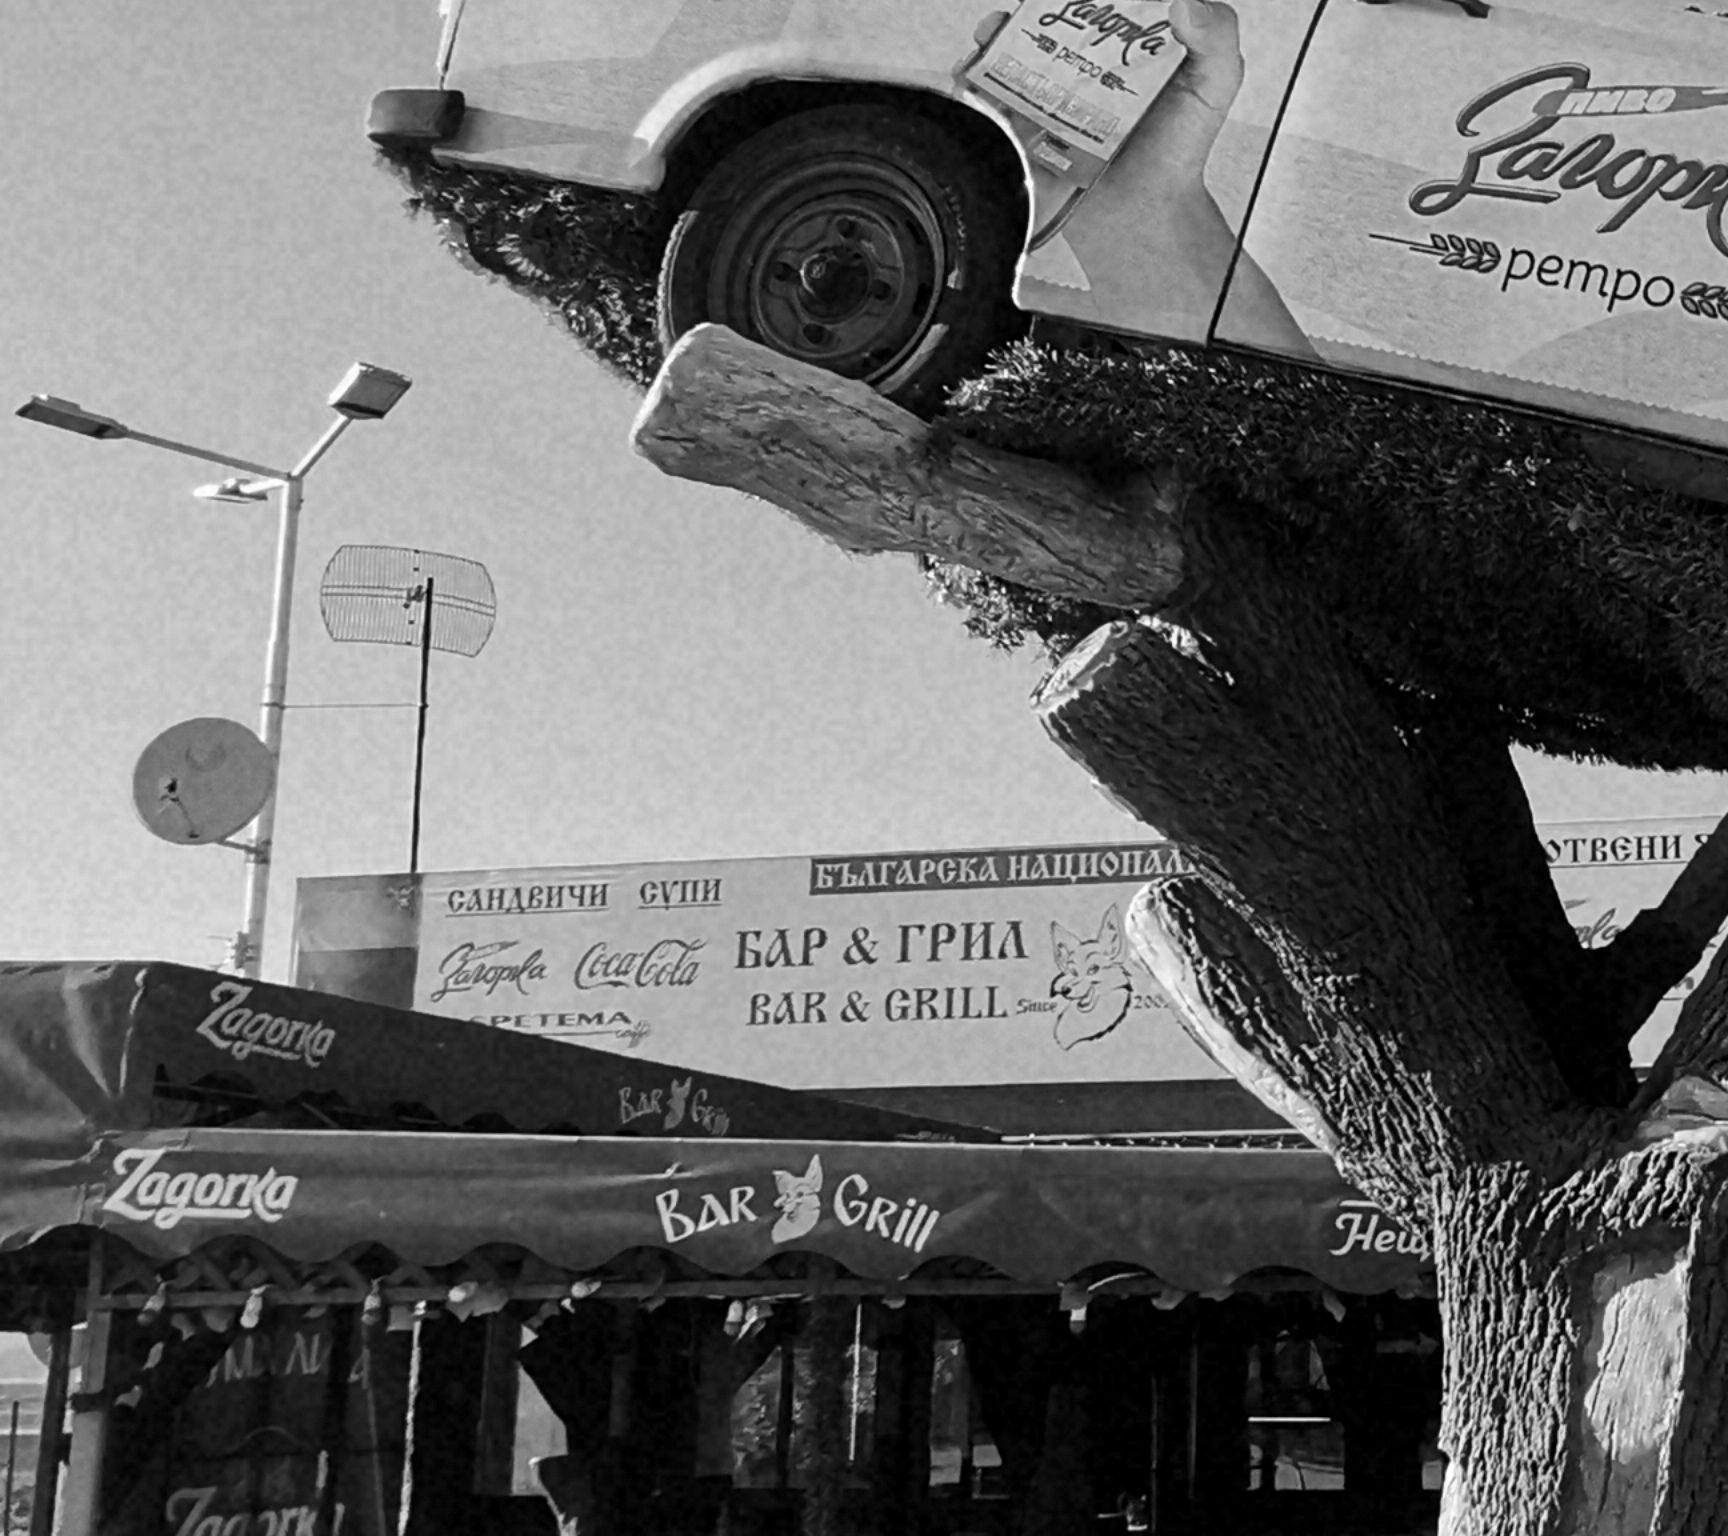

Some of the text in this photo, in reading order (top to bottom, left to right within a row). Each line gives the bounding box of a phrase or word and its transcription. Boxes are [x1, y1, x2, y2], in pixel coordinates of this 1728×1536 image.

[1501, 244, 1675, 312] ретро
[813, 855, 1000, 889] БЪЛГАРСКА
[1544, 834, 1683, 864] ОТВЕНИ
[447, 878, 722, 913] САНДВИЧИ СУПИ
[735, 920, 1030, 969] БАР & ГРИЛ
[196, 979, 337, 1068] Zagorka
[746, 985, 1009, 1026] BAR & GRILL
[103, 1147, 298, 1230] Zagorka
[1329, 1211, 1432, 1263] Нещ
